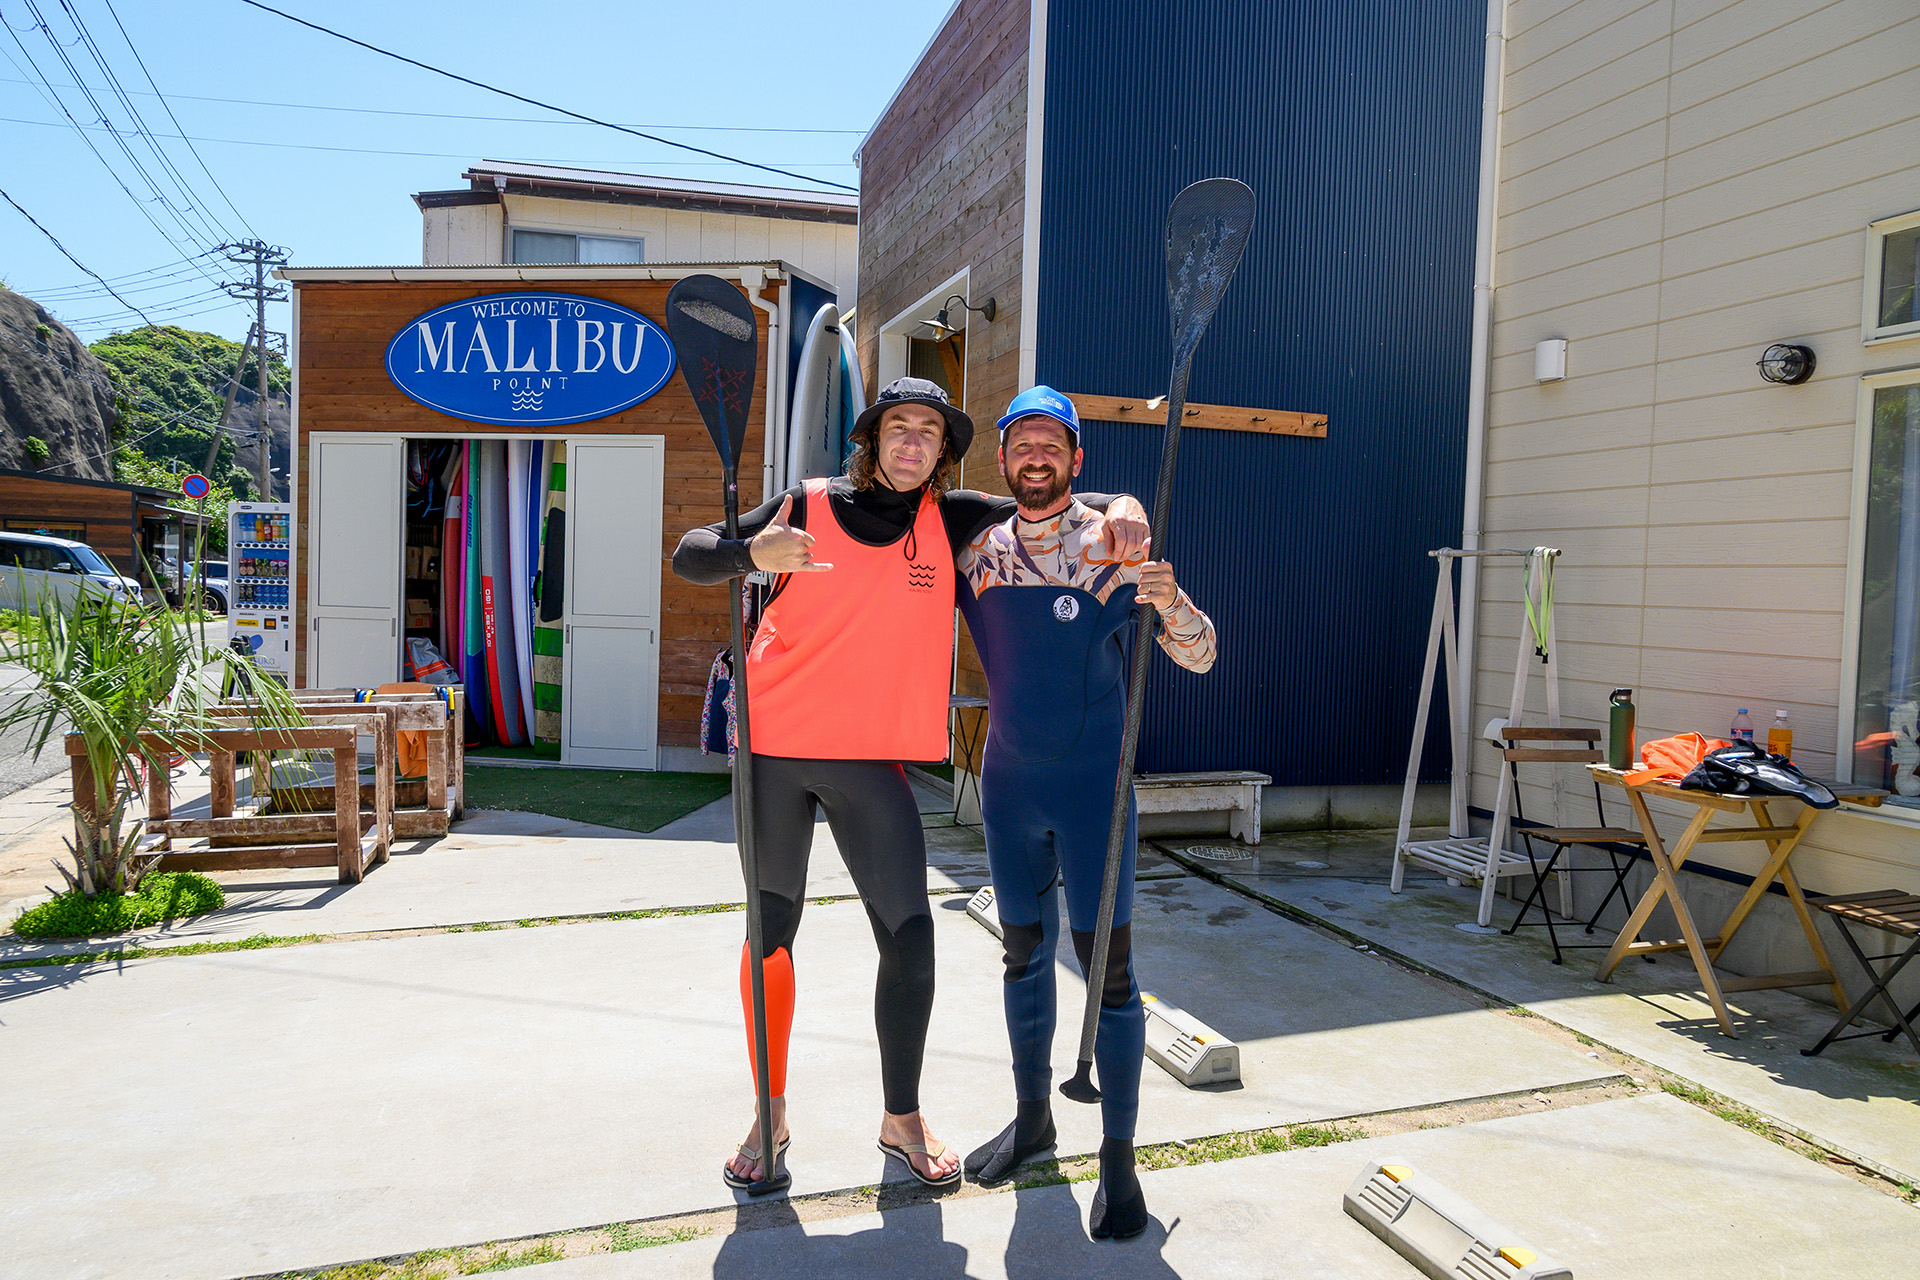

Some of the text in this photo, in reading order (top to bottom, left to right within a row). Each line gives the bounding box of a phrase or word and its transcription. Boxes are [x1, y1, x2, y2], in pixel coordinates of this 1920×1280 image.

[471, 300, 586, 319] WELCOME TO
[414, 318, 649, 375] MALIBU
[492, 376, 568, 391] POINT
